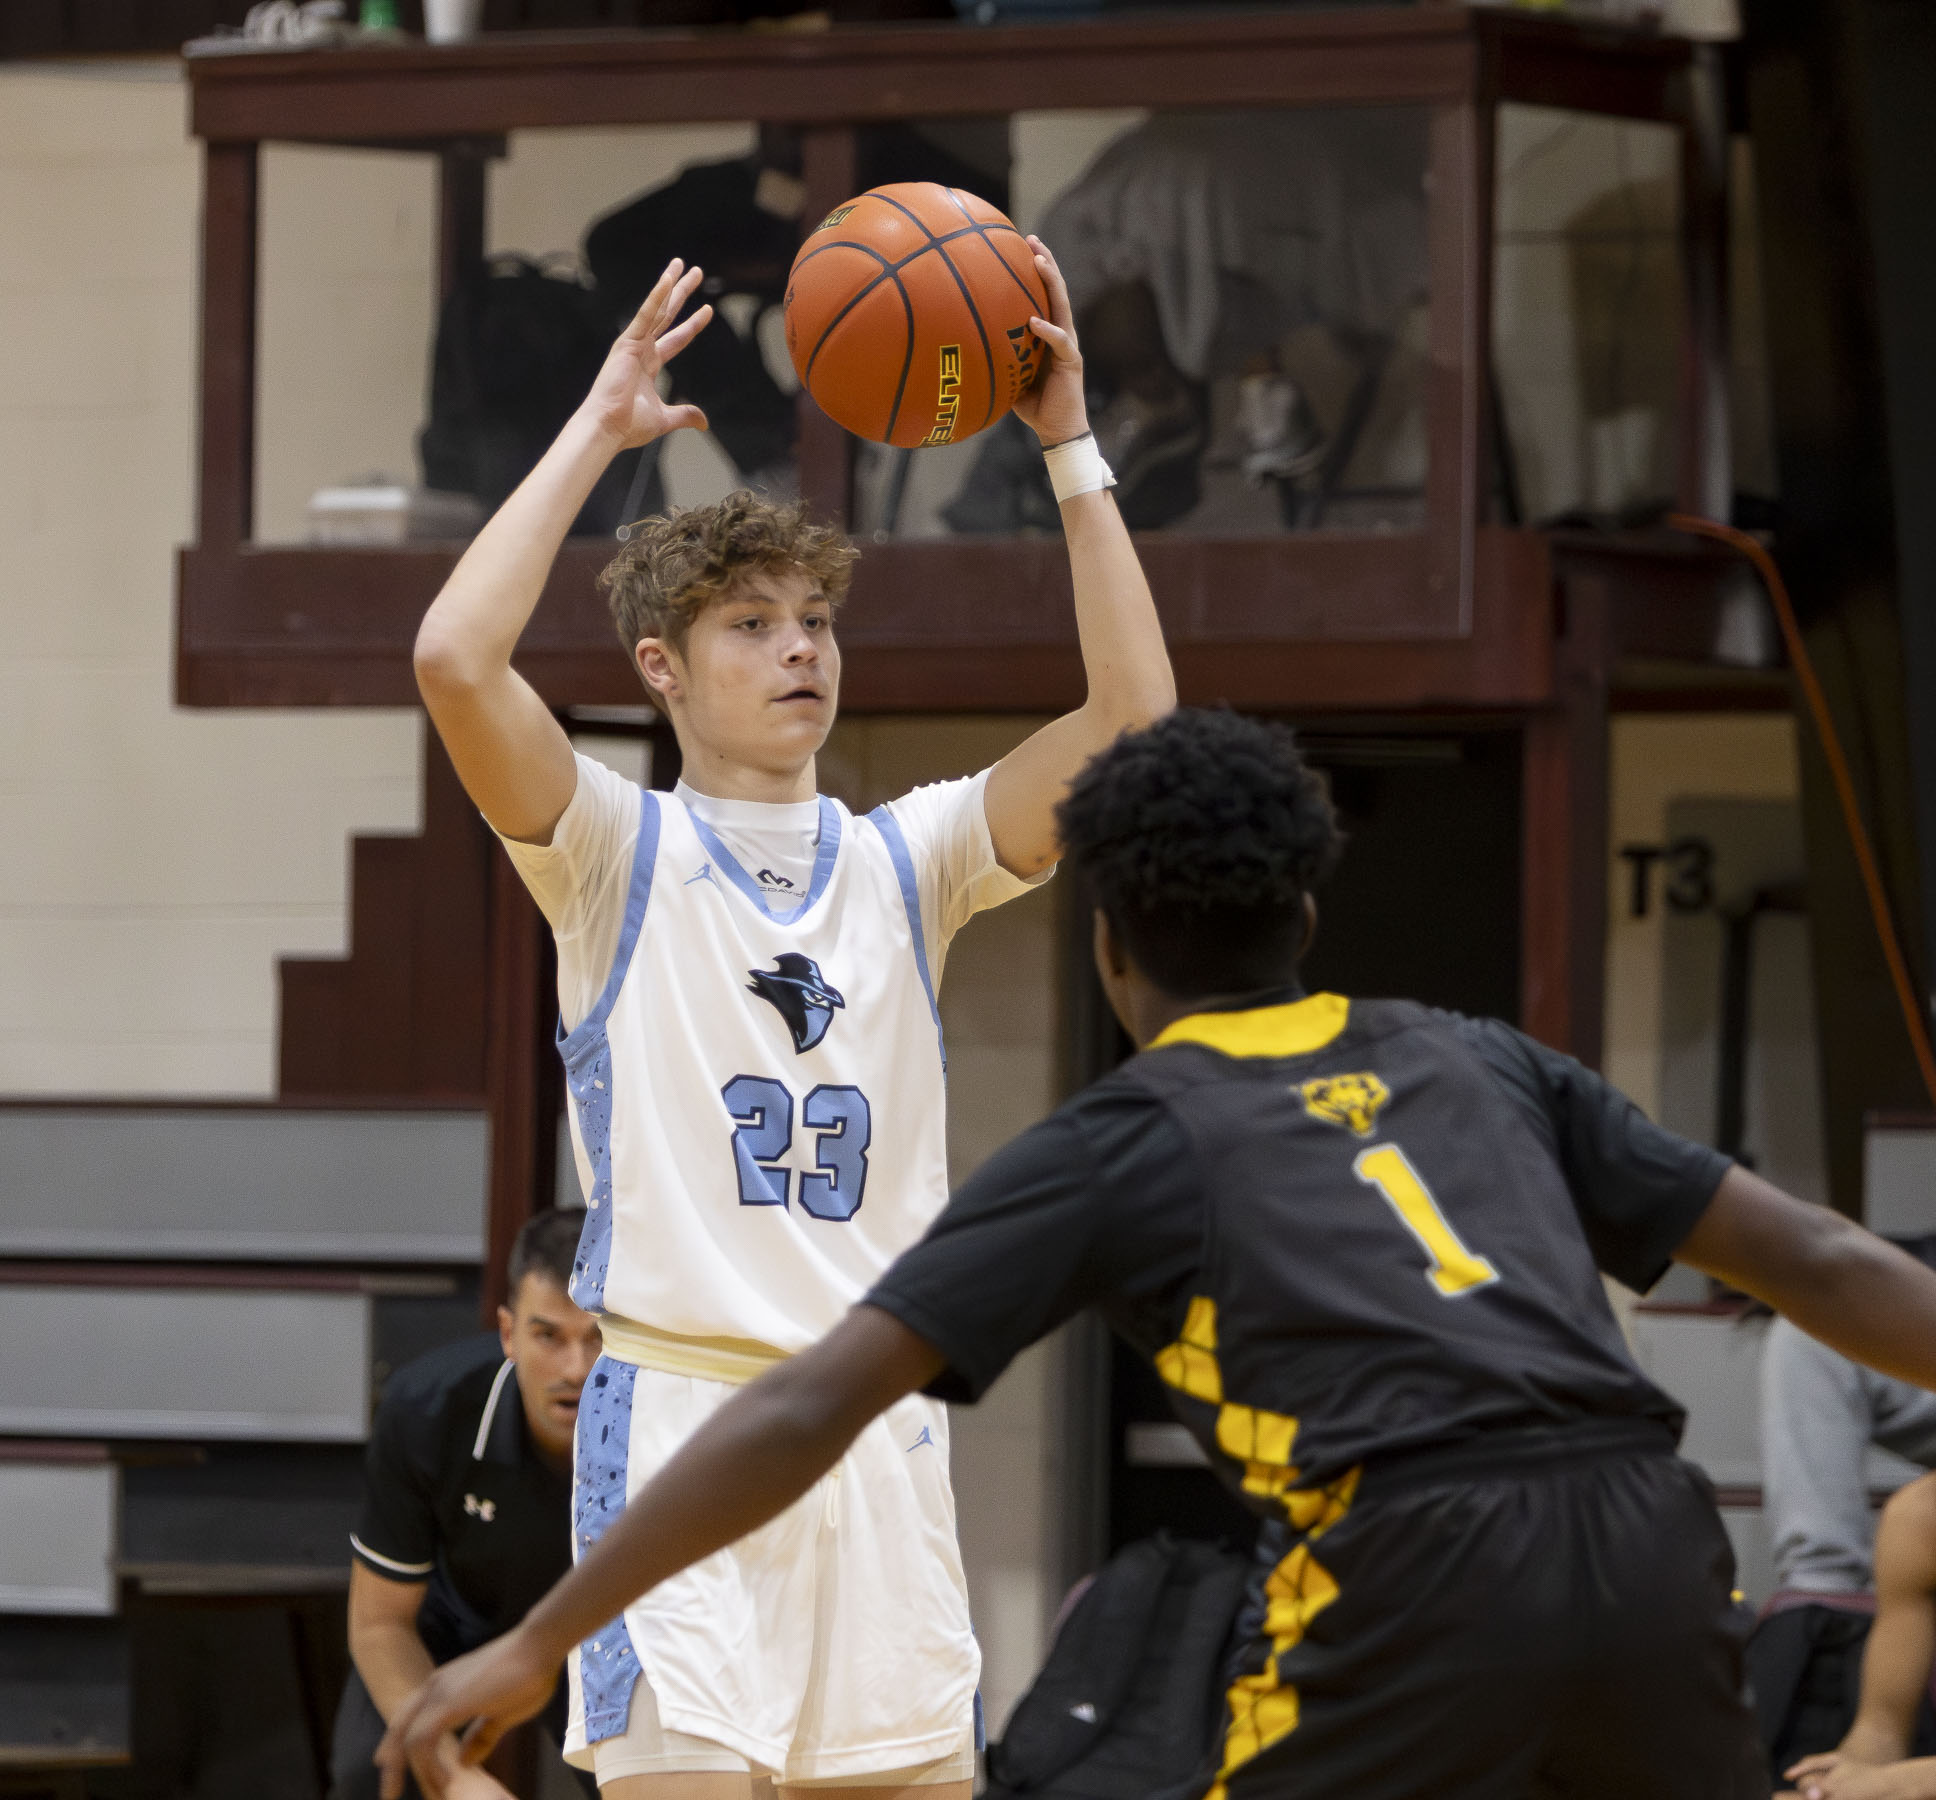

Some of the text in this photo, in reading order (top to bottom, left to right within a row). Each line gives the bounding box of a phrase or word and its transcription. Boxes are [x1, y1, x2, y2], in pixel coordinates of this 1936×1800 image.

[927, 344, 961, 442] ELITE
[1620, 836, 1716, 919] T3
[720, 1073, 872, 1222] 23
[1353, 1142, 1500, 1297] 1
